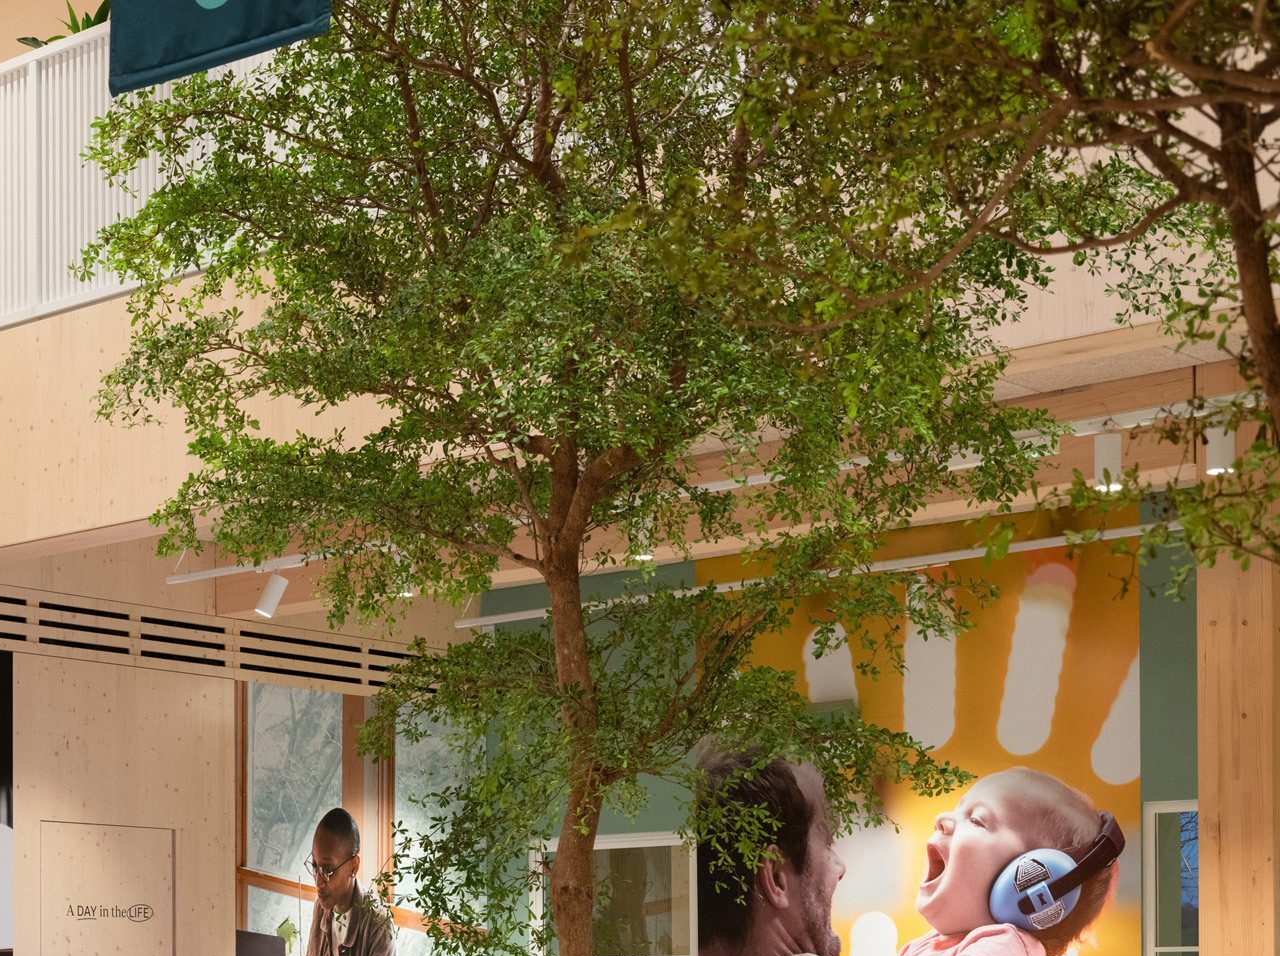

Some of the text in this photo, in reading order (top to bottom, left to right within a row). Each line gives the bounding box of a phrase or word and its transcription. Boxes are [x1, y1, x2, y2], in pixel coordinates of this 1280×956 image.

[66, 904, 149, 918] A DAY in the LIFE
